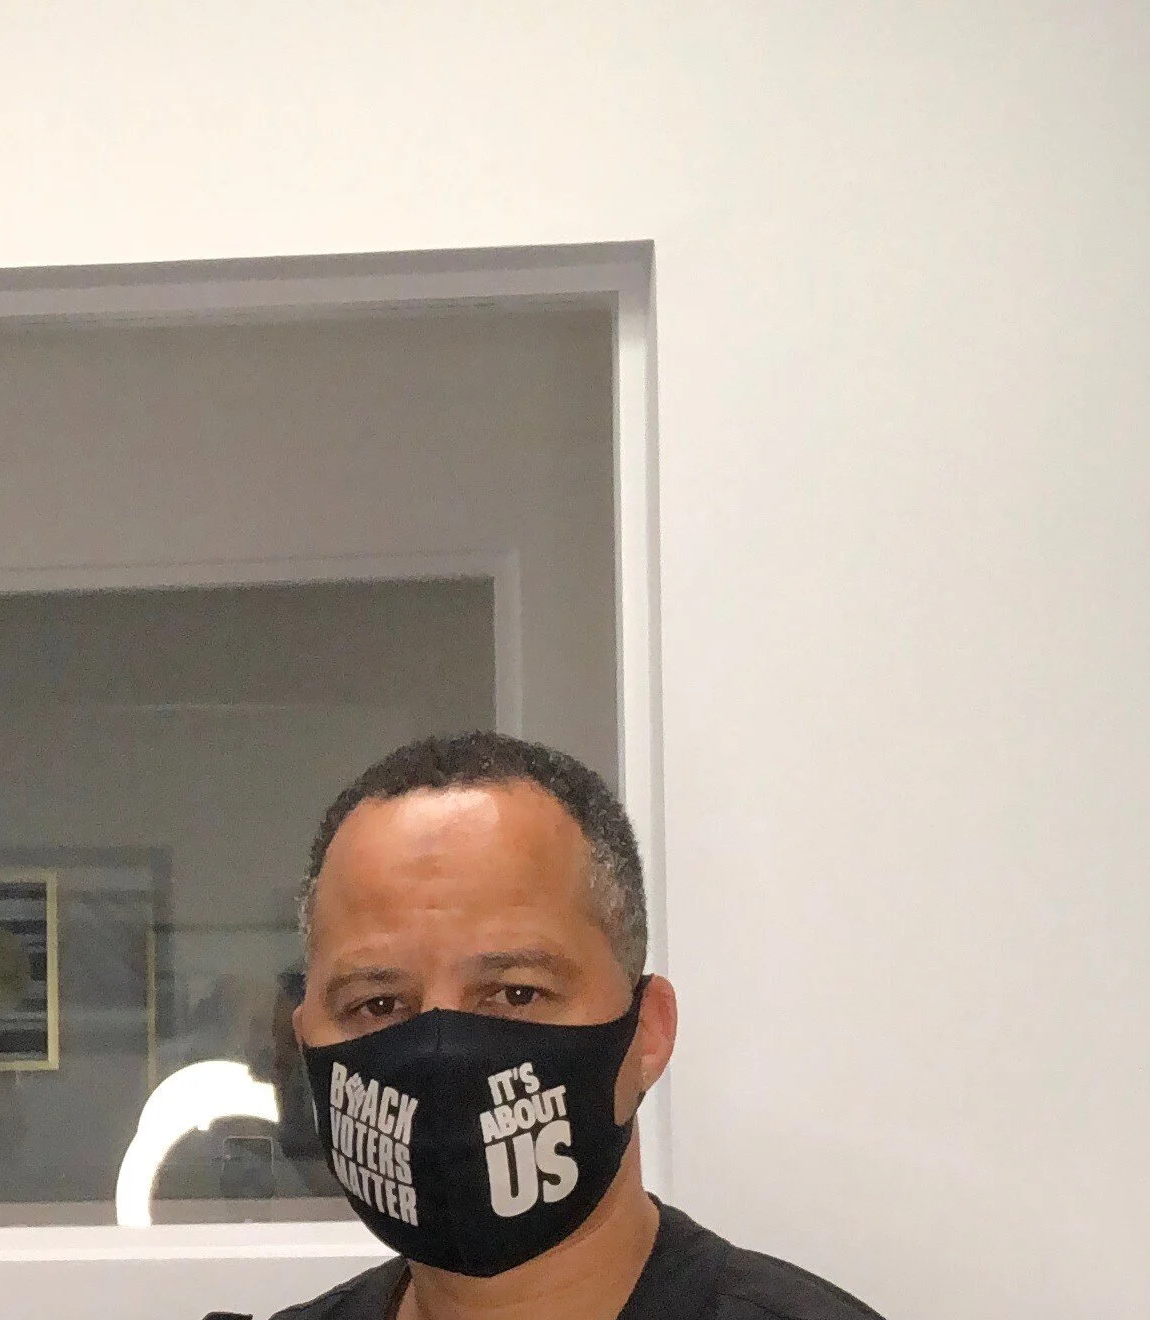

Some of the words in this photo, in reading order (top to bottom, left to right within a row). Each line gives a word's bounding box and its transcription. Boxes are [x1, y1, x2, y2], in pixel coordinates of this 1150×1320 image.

[480, 1085, 567, 1144] ABOUT
[488, 1062, 540, 1106] IT'S
[330, 1107, 413, 1184] VOTERS
[485, 1120, 579, 1218] US
[332, 1148, 419, 1227] MATTER
